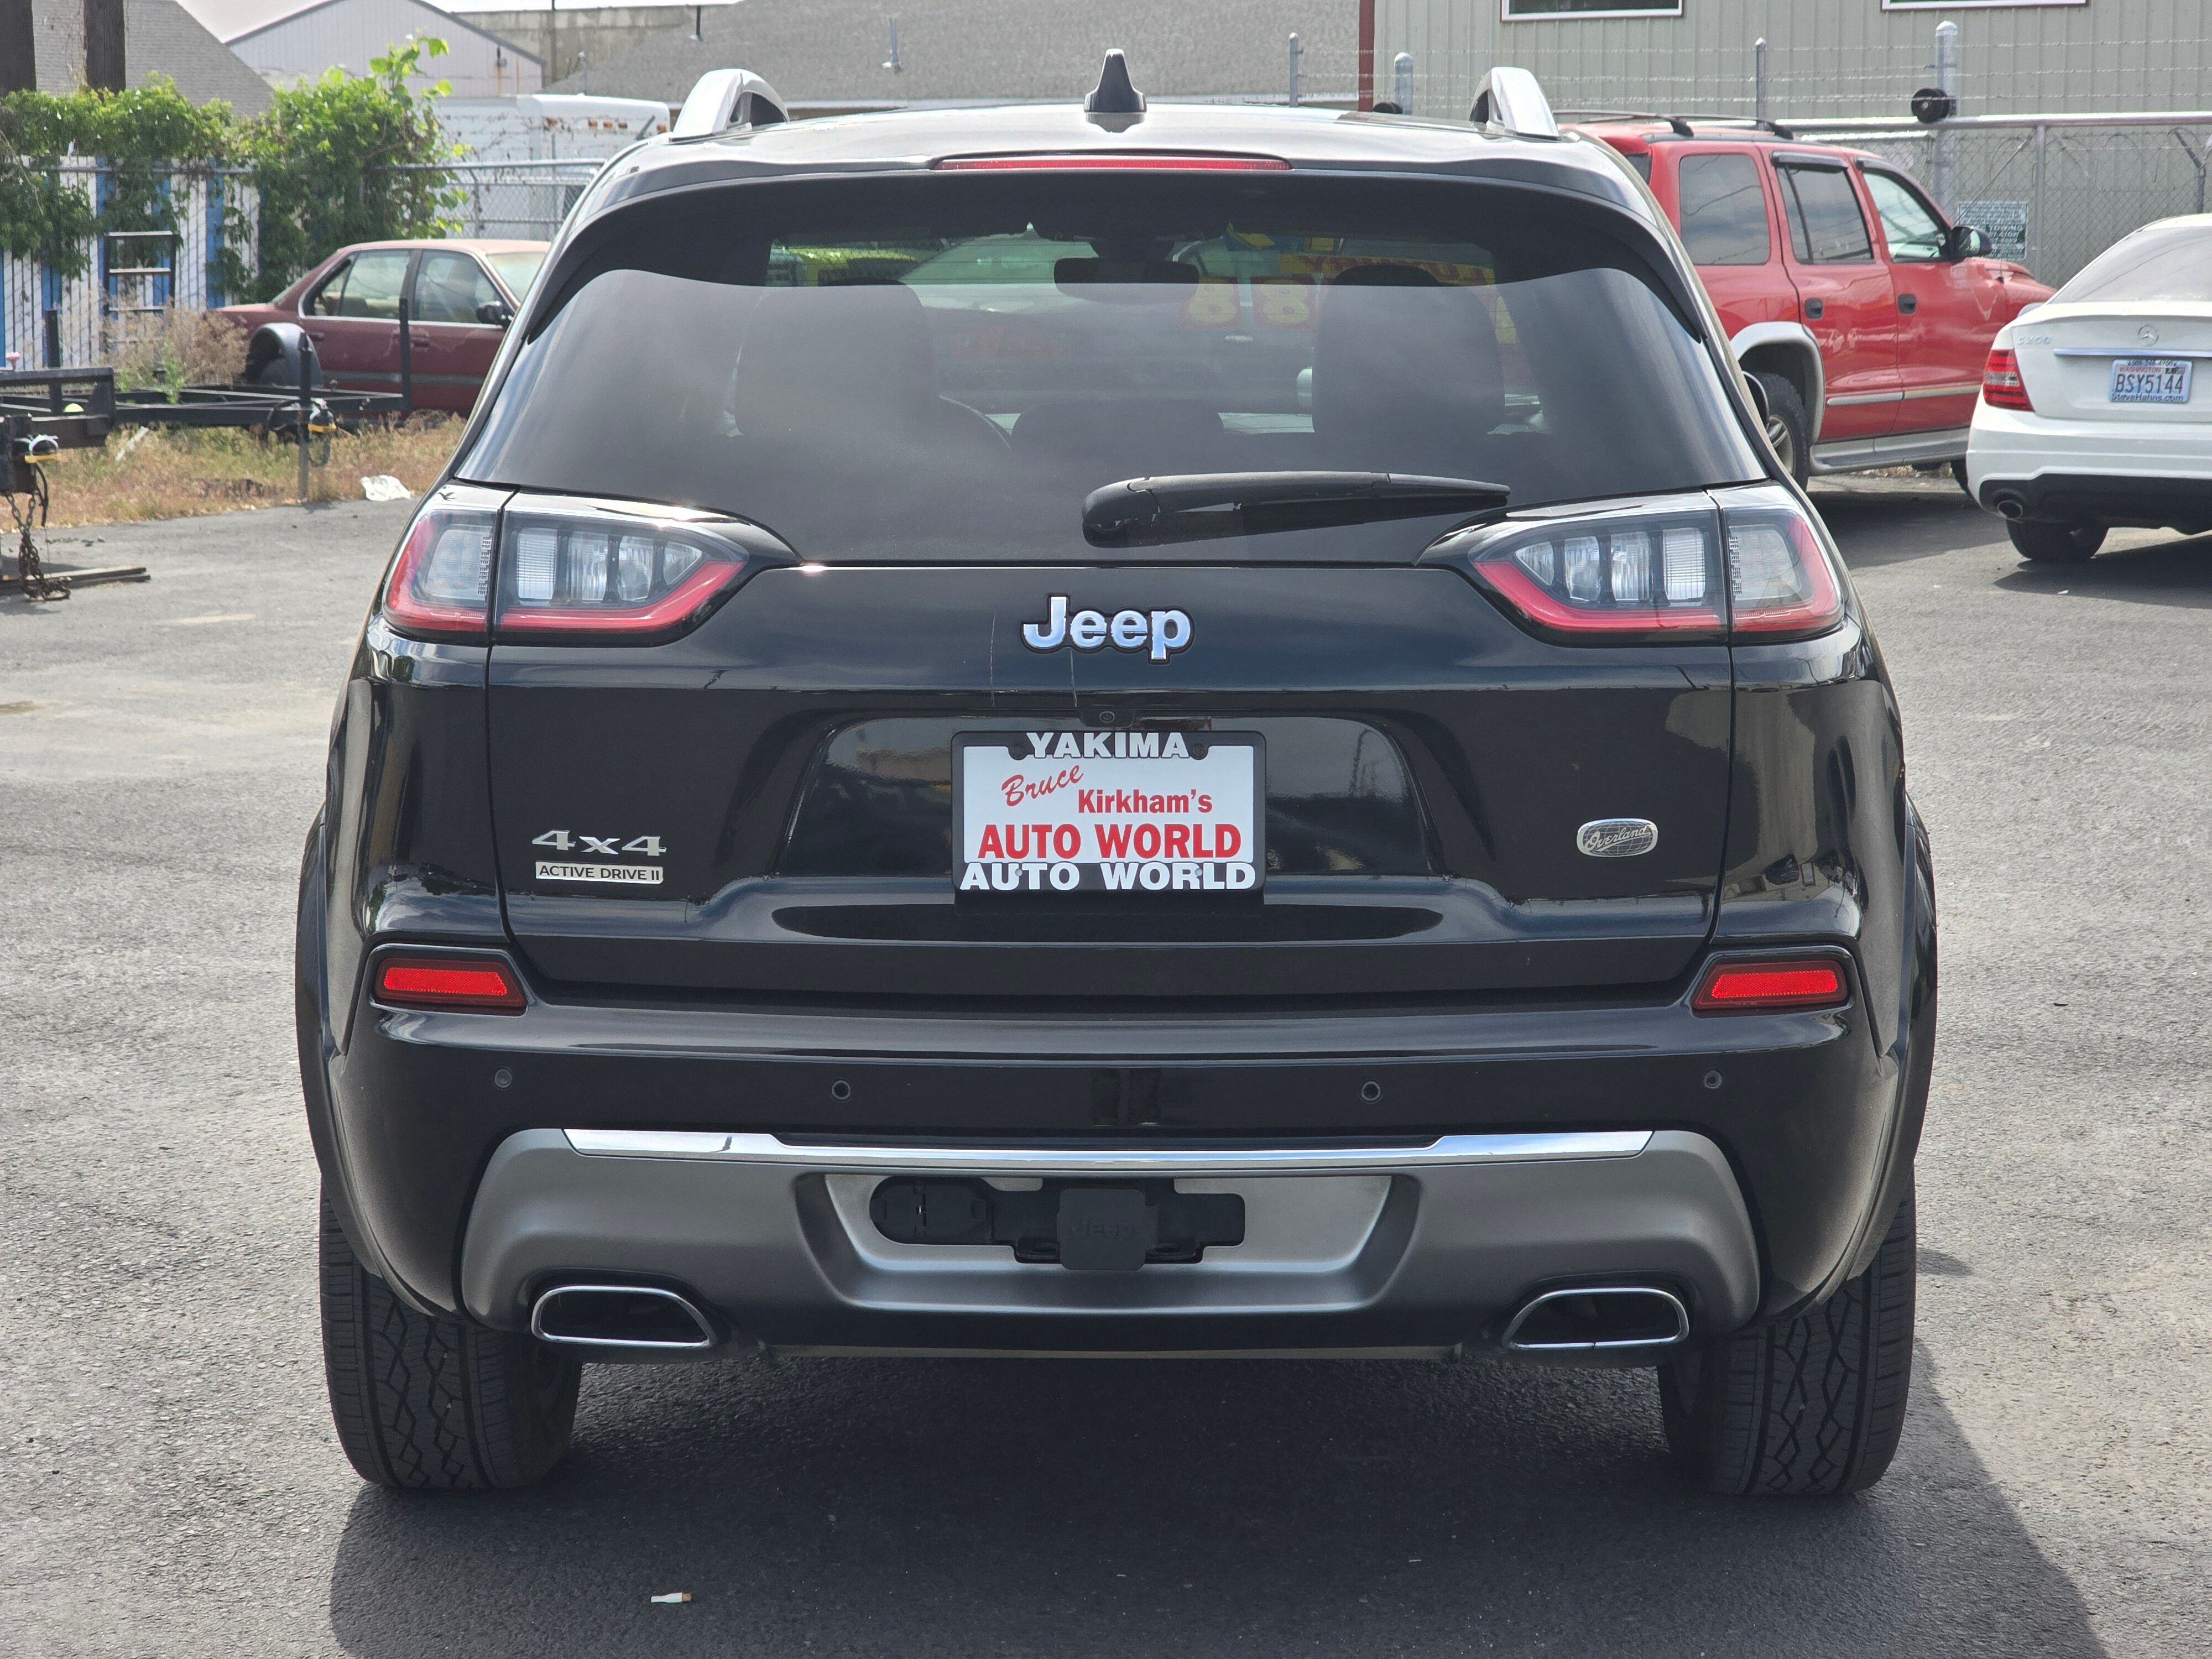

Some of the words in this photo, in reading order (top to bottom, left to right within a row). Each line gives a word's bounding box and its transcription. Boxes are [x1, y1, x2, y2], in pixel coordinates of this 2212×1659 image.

[2115, 374, 2184, 394] BSY5144
[1022, 596, 1191, 660] Jeep
[1026, 732, 1190, 758] YAKIMA
[1001, 764, 1084, 807] Bruce
[1078, 789, 1213, 813] Kirkham's
[532, 830, 667, 856] 4x4
[977, 823, 1081, 859] AUTO
[1094, 823, 1241, 859] WORLD
[1585, 825, 1651, 852] Overland
[539, 865, 594, 878] ACTIVE
[600, 868, 647, 880] DRIVE
[651, 870, 660, 881] II
[959, 862, 1080, 890] AUTO
[1100, 862, 1256, 890] WORLD
